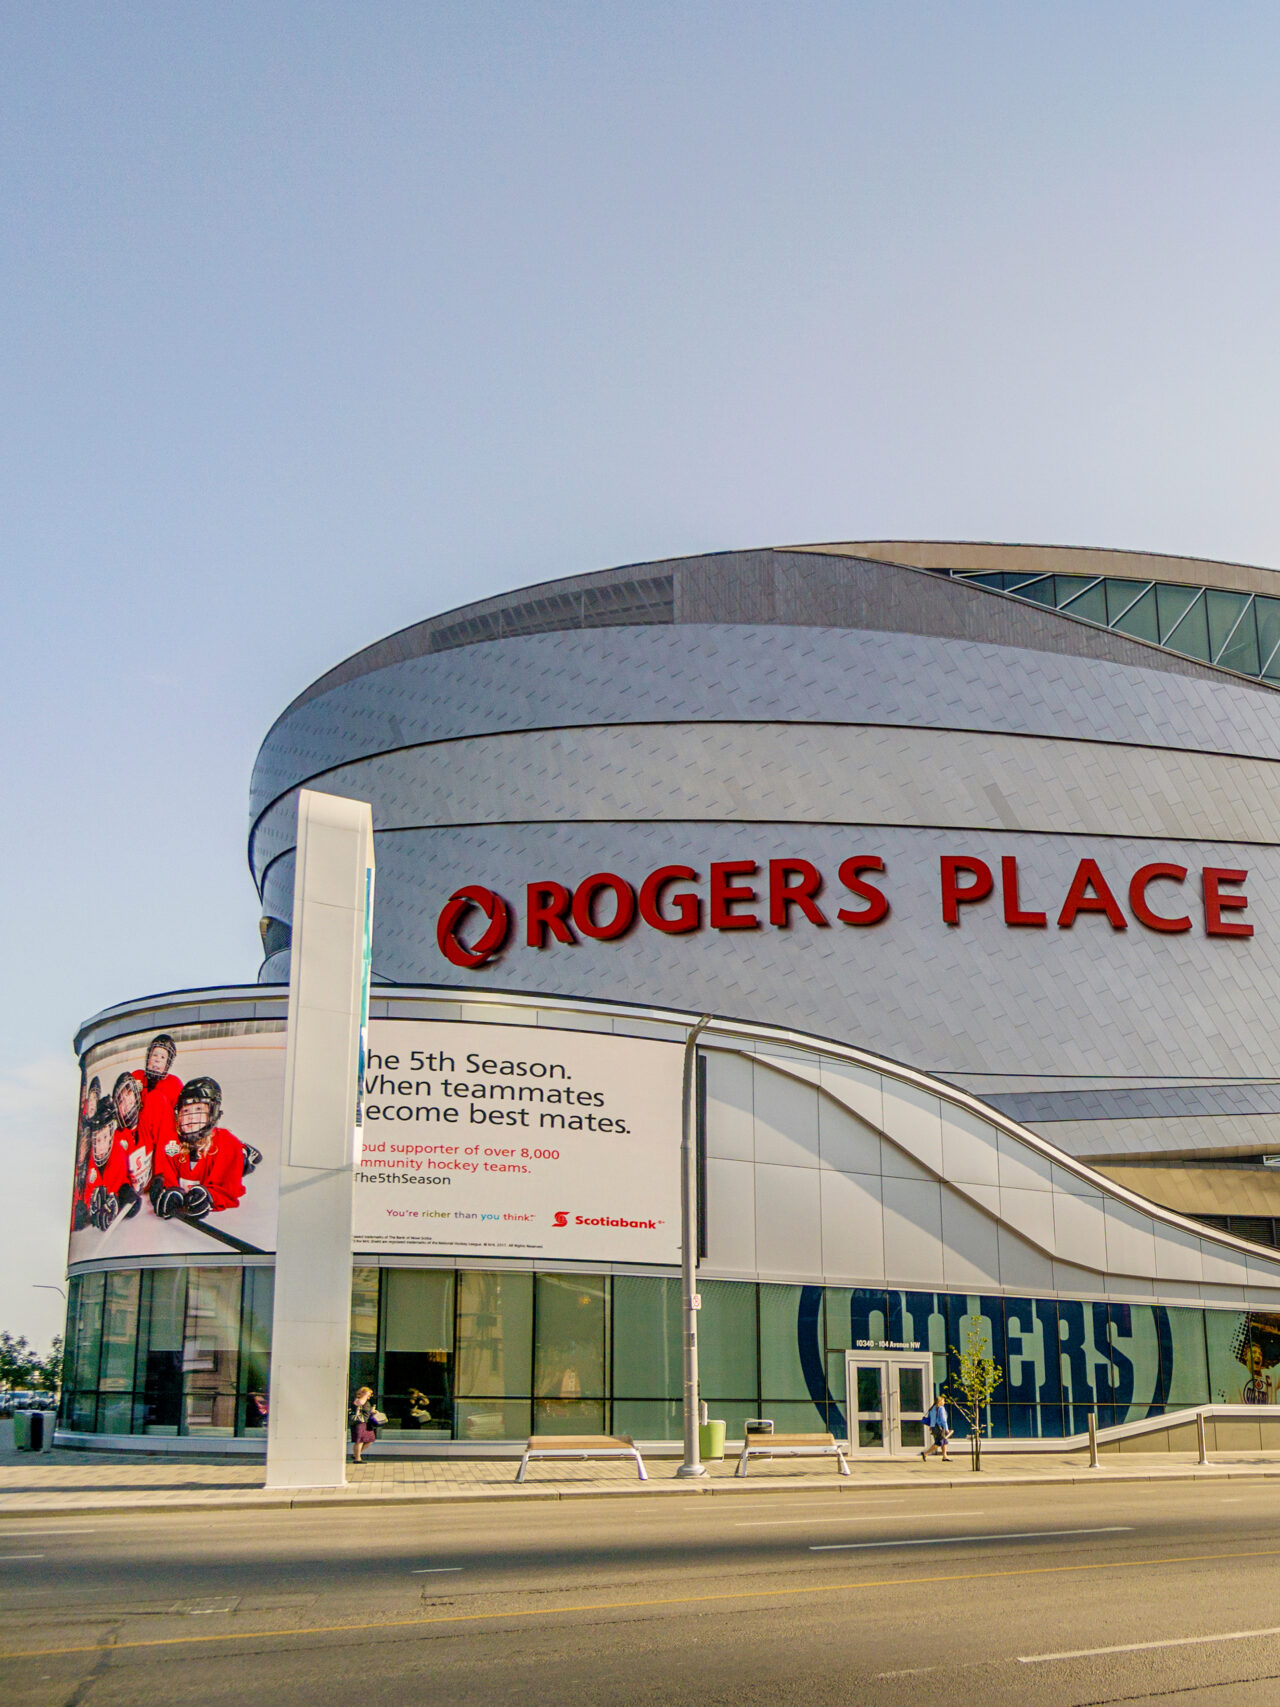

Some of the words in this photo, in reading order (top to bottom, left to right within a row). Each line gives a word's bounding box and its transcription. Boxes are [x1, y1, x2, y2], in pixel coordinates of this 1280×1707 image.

[526, 855, 890, 949] ROGERS
[940, 854, 1255, 938] PLACE
[367, 1048, 400, 1071] he
[410, 1050, 455, 1072] 5th
[466, 1053, 572, 1080] Season.
[441, 1079, 605, 1108] teammates
[366, 1104, 459, 1123] ecome
[470, 1102, 530, 1127] best
[540, 1112, 631, 1135] mates.
[390, 1143, 460, 1156] supporter
[464, 1144, 481, 1156] of
[484, 1147, 517, 1158] over
[521, 1147, 560, 1161] 8,000
[360, 1157, 423, 1172] mmunity
[427, 1158, 479, 1174] hockey
[483, 1161, 532, 1174] teams.
[387, 1208, 419, 1218] You're
[422, 1209, 452, 1219] richer
[454, 1210, 478, 1220] than
[481, 1212, 500, 1222] you
[856, 1339, 875, 1348] 10340
[910, 1341, 921, 1350] NW
